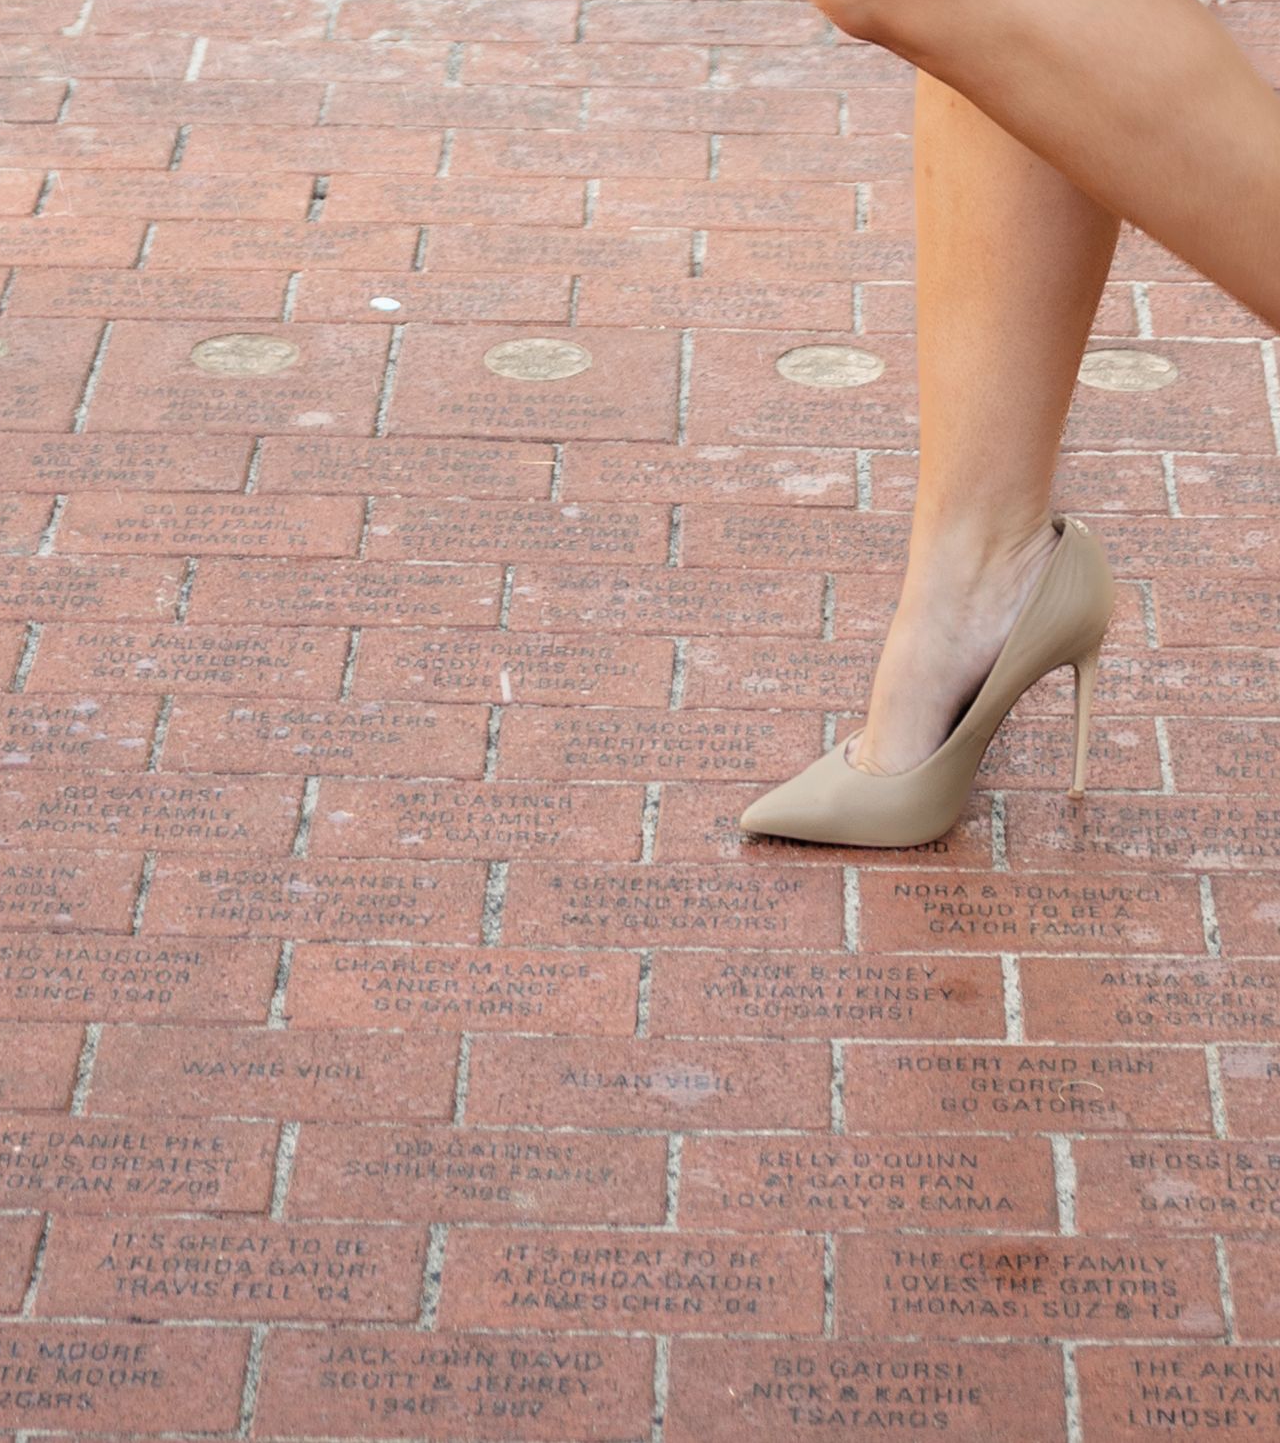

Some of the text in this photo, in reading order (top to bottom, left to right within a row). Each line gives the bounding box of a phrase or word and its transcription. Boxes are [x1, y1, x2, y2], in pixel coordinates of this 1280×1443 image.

[893, 885, 1161, 901] NORA & TOM BUCCI
[923, 903, 1133, 918] PROUD TO BE A
[928, 920, 1126, 935] GATOR FAMILY
[182, 1062, 363, 1079] WAYNE VIGIL
[559, 1074, 734, 1090] ALLAN VIGIL
[47, 1134, 147, 1149] DANIEL
[164, 1137, 223, 1151] PIKE
[90, 1157, 238, 1172] GREATEST
[758, 1152, 979, 1168] KELLY O'QUINN
[807, 1174, 905, 1188] GATOR
[918, 1175, 975, 1189] FAN
[721, 1193, 1014, 1211] LOVE ALLY & EMMA
[111, 1233, 365, 1256] IT'S GREAT TO BE
[96, 1256, 121, 1270] A
[128, 1258, 253, 1273] FLORIDA
[116, 1278, 224, 1295] TRAVIS
[231, 1282, 290, 1299] FELL
[1130, 1361, 1182, 1376] THE
[747, 1383, 982, 1403] NICK & KATHIE
[1128, 1409, 1257, 1427] LINDSEY
